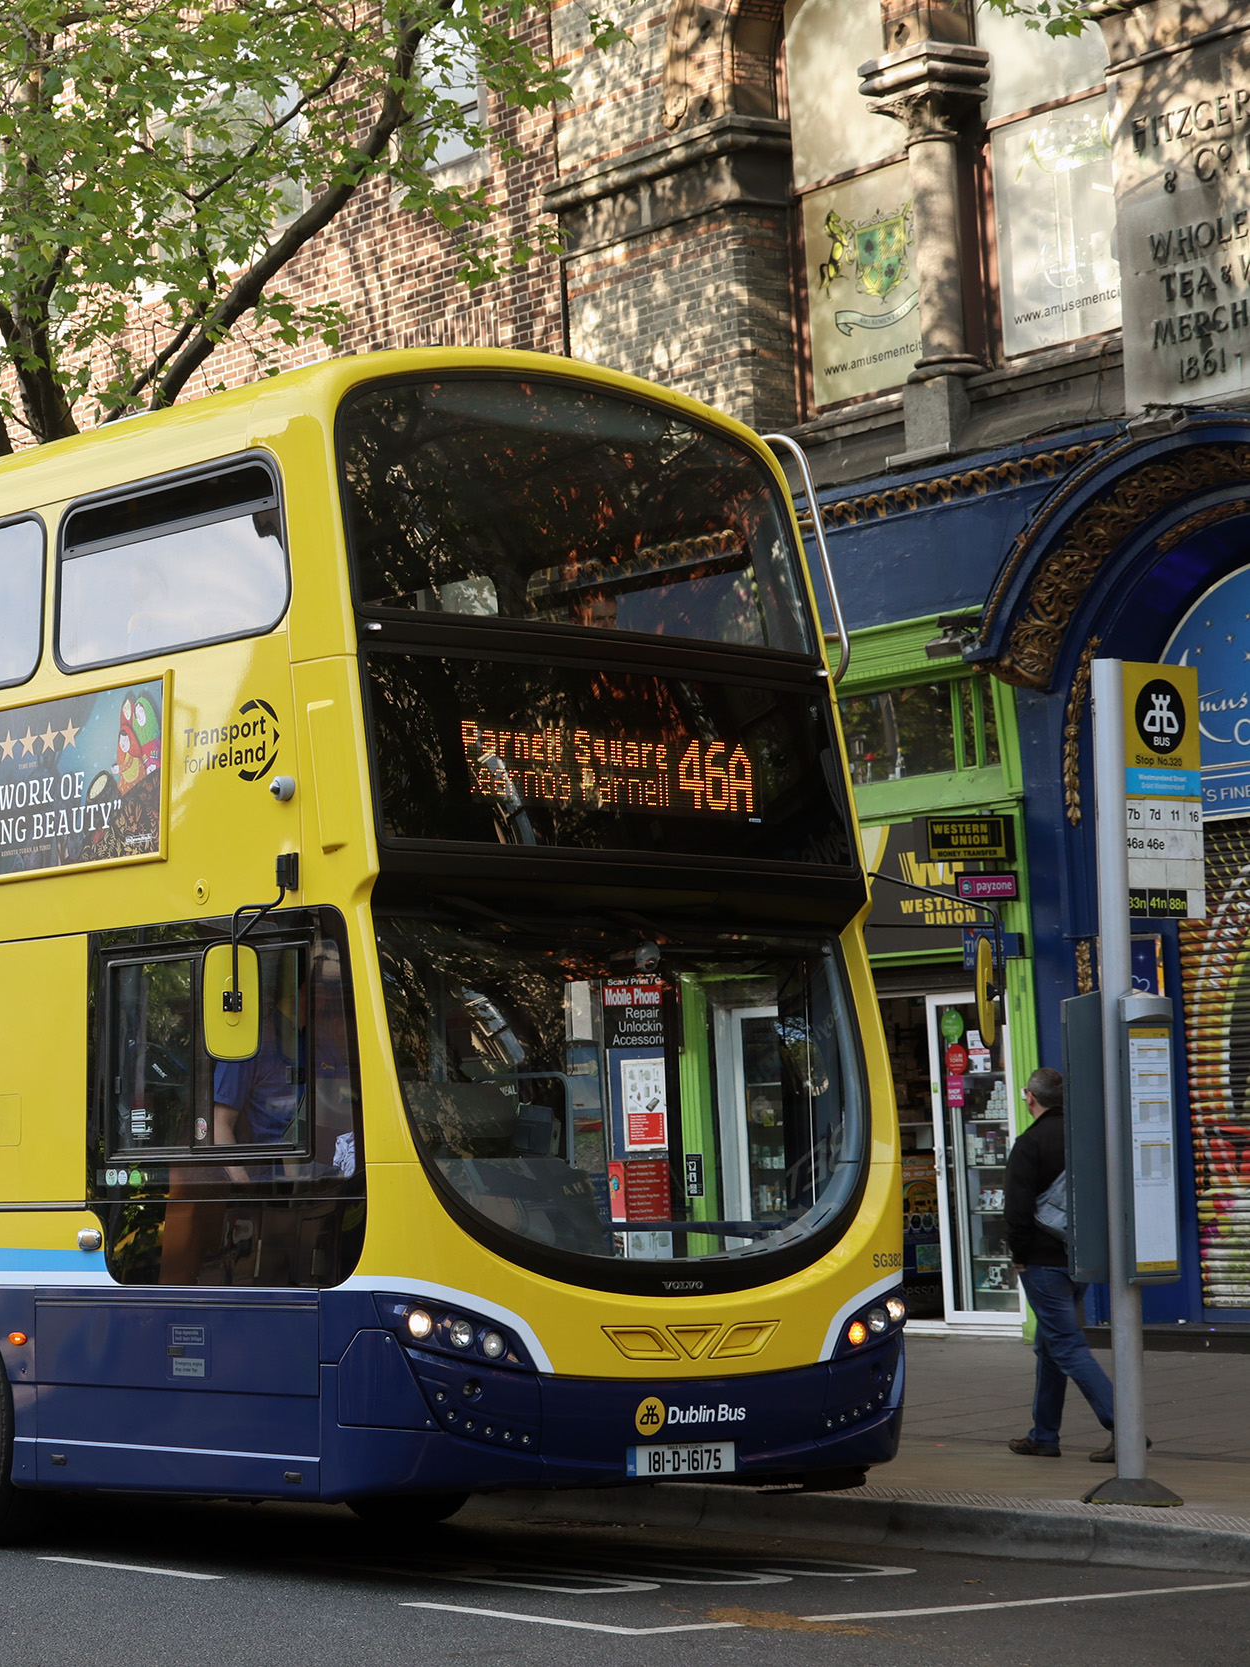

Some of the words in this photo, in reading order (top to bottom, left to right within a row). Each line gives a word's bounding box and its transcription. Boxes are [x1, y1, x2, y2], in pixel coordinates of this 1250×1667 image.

[1164, 170, 1177, 193] &
[1160, 266, 1216, 302] TEA
[1220, 263, 1232, 284] &
[1178, 347, 1226, 384] 1861
[184, 716, 266, 748] Transport
[461, 720, 561, 762] Parnell
[573, 729, 668, 770] Square
[1153, 736, 1170, 747] BUS
[184, 755, 204, 774] for
[206, 740, 266, 770] Ireland
[1135, 755, 1154, 767] Stop
[1157, 756, 1182, 767] No.320
[678, 739, 754, 812] 46A
[60, 771, 85, 800] OF
[581, 767, 670, 807] Parnell
[1128, 808, 1140, 820] 7b
[1149, 809, 1161, 820] 7d
[1170, 810, 1180, 821] 11
[1189, 811, 1199, 822] 16
[932, 823, 988, 834] WESTERN
[950, 834, 988, 845] UNION
[1147, 838, 1165, 850] 46e
[963, 849, 998, 857] TRANSFER
[976, 881, 1012, 894] payzone
[1149, 897, 1167, 909] 41n
[1169, 898, 1187, 910] 88n
[925, 908, 977, 924] UNION
[605, 988, 632, 1006] Mobile
[633, 987, 660, 1005] Phone
[625, 1006, 660, 1021] Repair
[618, 1020, 663, 1033] Unlockin
[872, 1252, 902, 1269] SG382
[662, 1280, 704, 1290] VOLVO
[667, 1404, 716, 1425] Dublin
[717, 1403, 746, 1422] Bus
[648, 1448, 721, 1473] 181-D-16175
